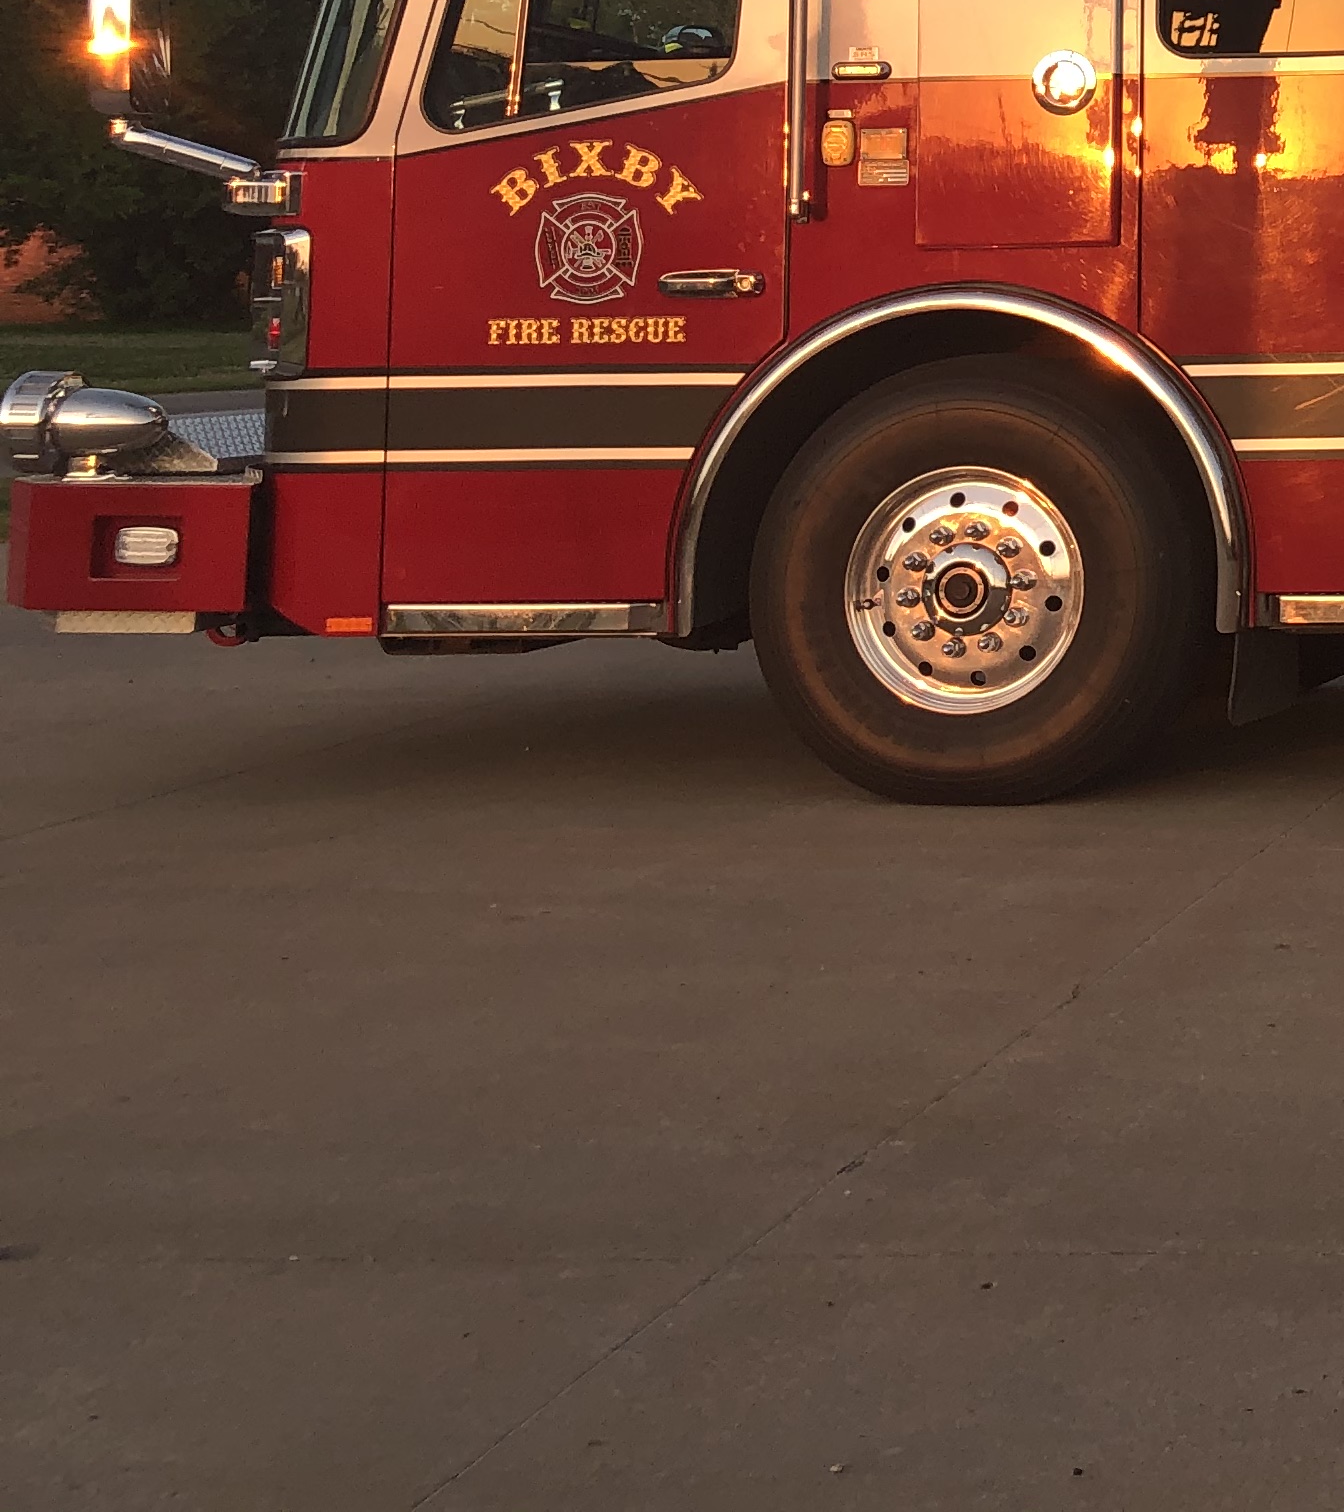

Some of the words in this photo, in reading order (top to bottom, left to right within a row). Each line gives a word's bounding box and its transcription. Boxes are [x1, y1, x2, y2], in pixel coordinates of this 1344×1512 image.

[489, 139, 703, 217] BIXBY
[487, 318, 561, 345] FIRE
[570, 316, 687, 345] RESCUE
